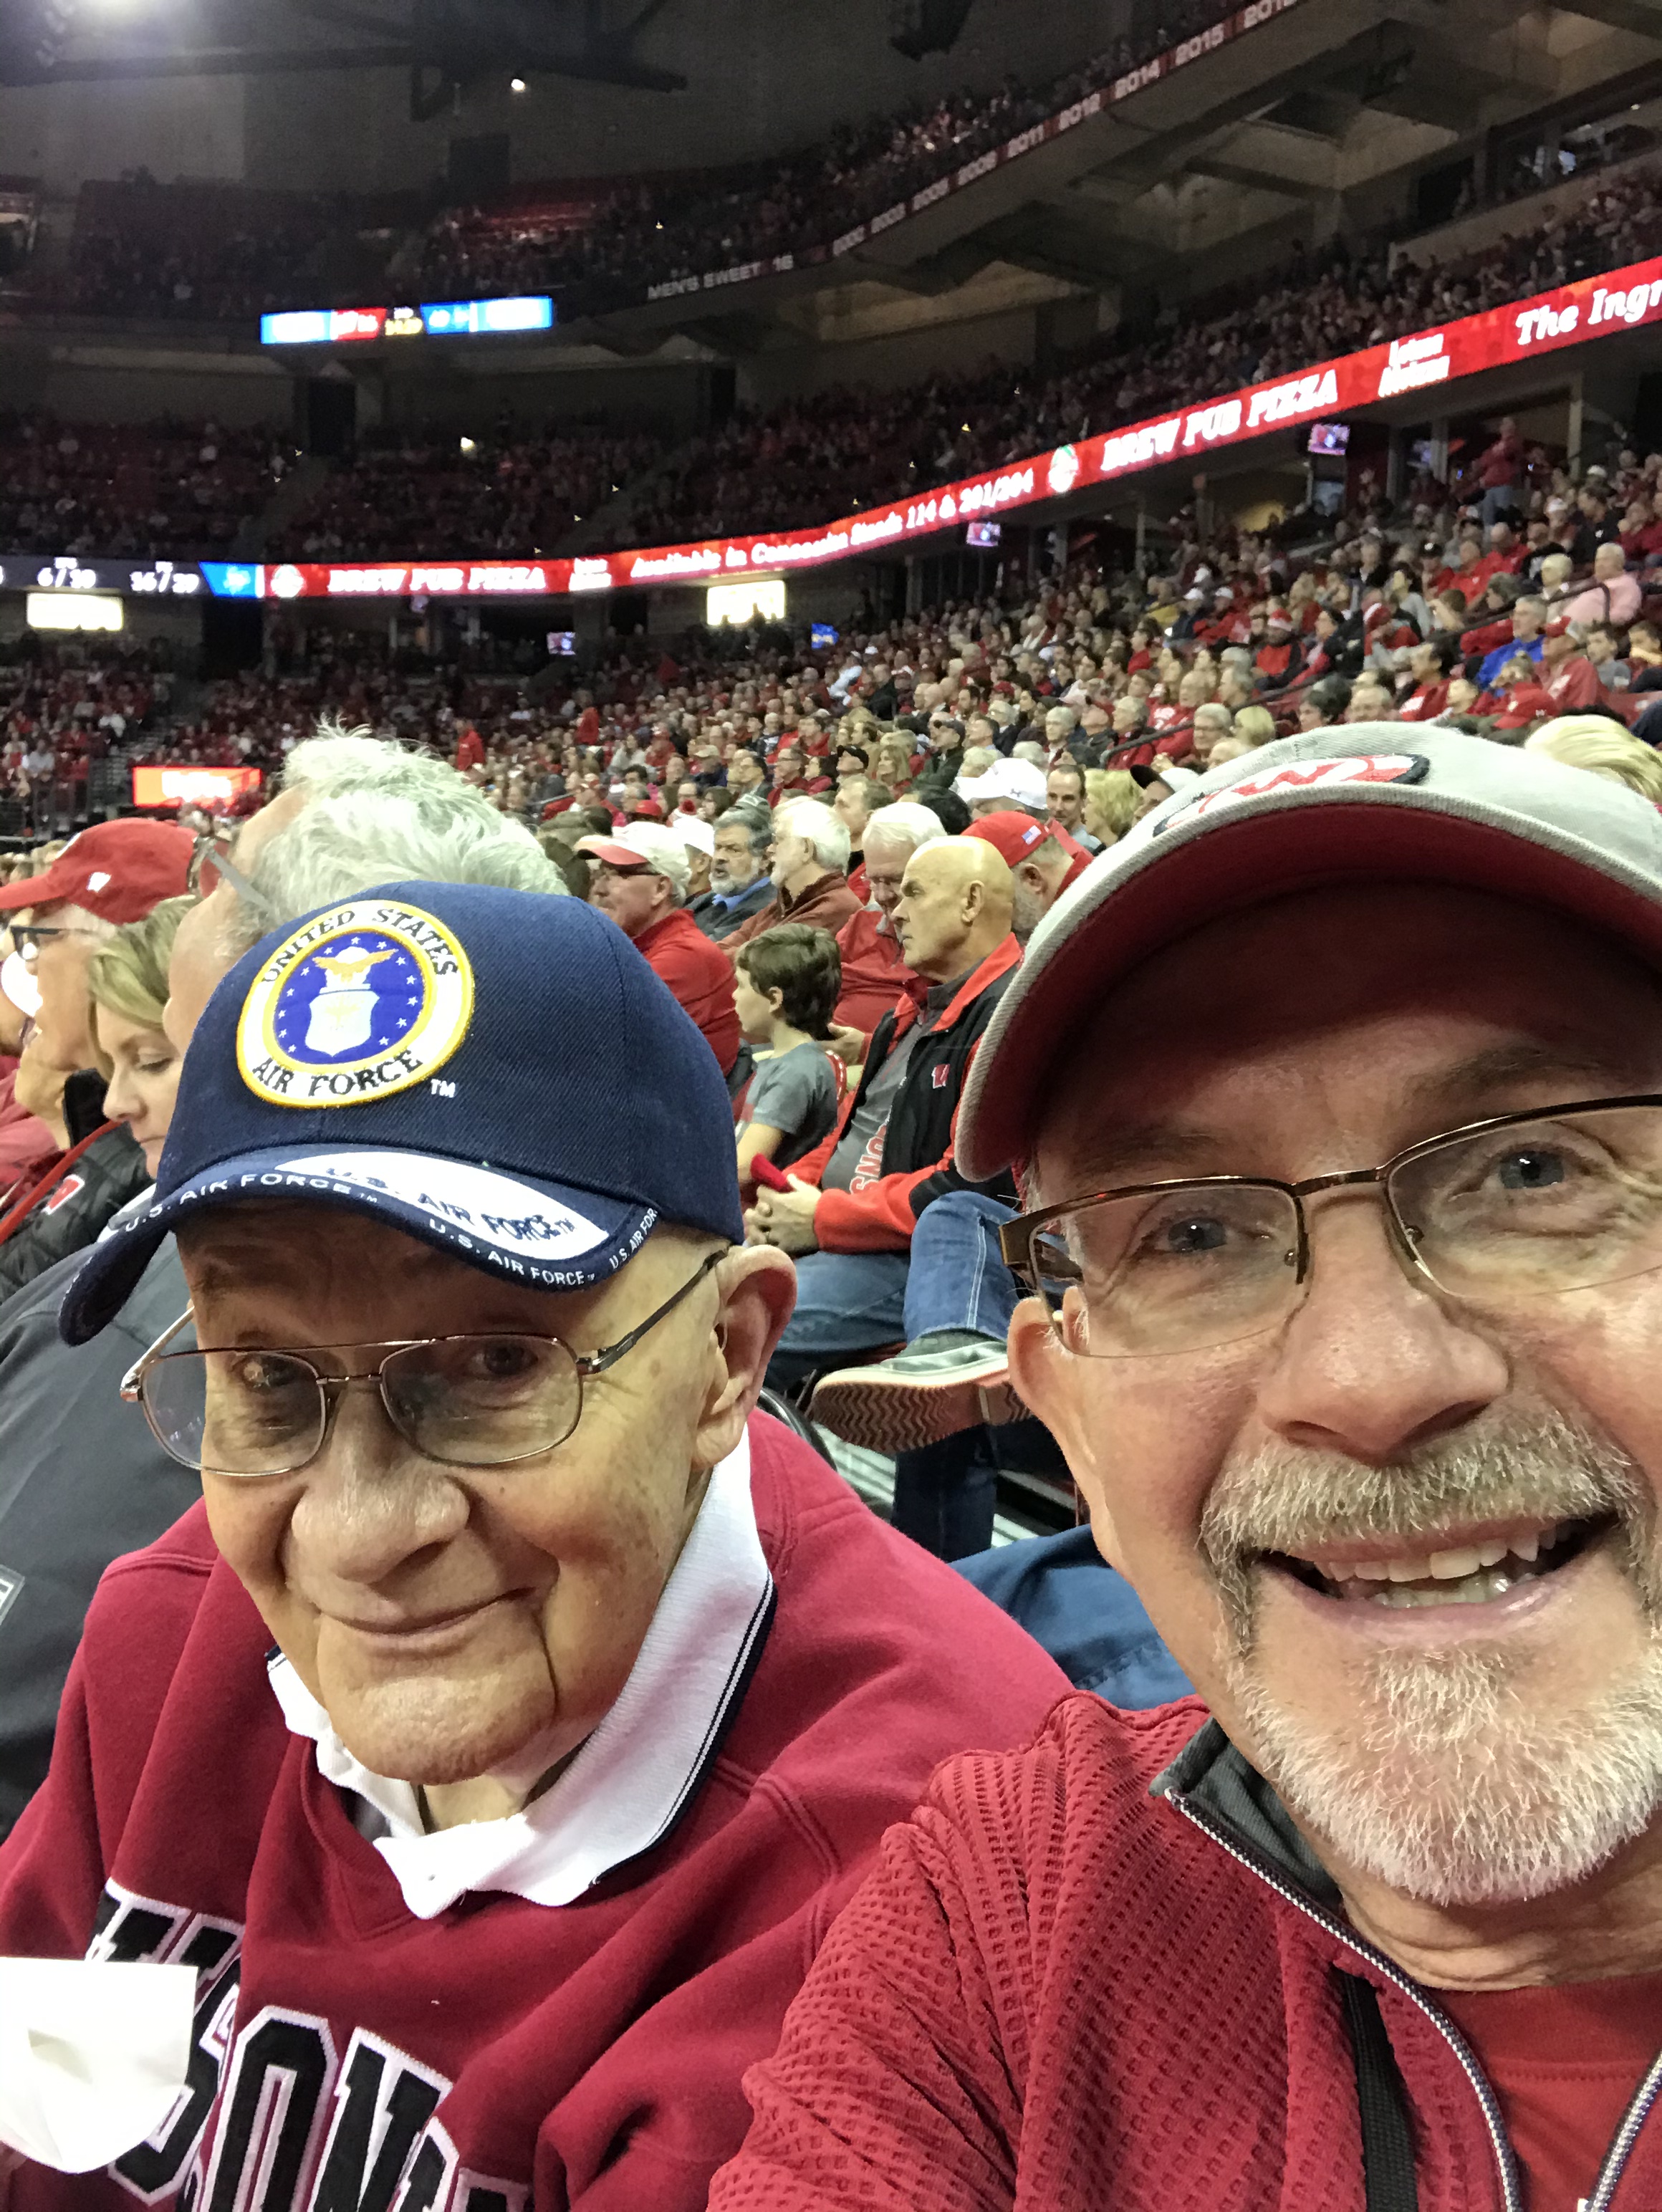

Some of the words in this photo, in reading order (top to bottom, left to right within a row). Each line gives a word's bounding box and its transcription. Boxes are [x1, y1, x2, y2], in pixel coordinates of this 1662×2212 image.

[1176, 23, 1224, 66] 2015
[1516, 304, 1579, 345] The
[1100, 418, 1181, 471] BREW
[1183, 399, 1241, 446] PUB
[1246, 369, 1338, 427] PIZZA
[409, 567, 464, 591] PUB
[467, 567, 547, 591] PIZZA
[261, 910, 356, 984] UNITED
[372, 908, 459, 976] STATES
[251, 1057, 294, 1094] AIR
[308, 1048, 424, 1097] FORCE
[431, 1079, 456, 1098] TM
[125, 1203, 171, 1232] U.S.
[179, 1179, 228, 1205] AIR
[241, 1173, 352, 1194] FORCE
[430, 1218, 481, 1254] U.S.
[488, 1250, 525, 1276] AIR
[530, 1266, 585, 1286] FORCE
[629, 1230, 644, 1254] AIR
[640, 1208, 658, 1235] FOR
